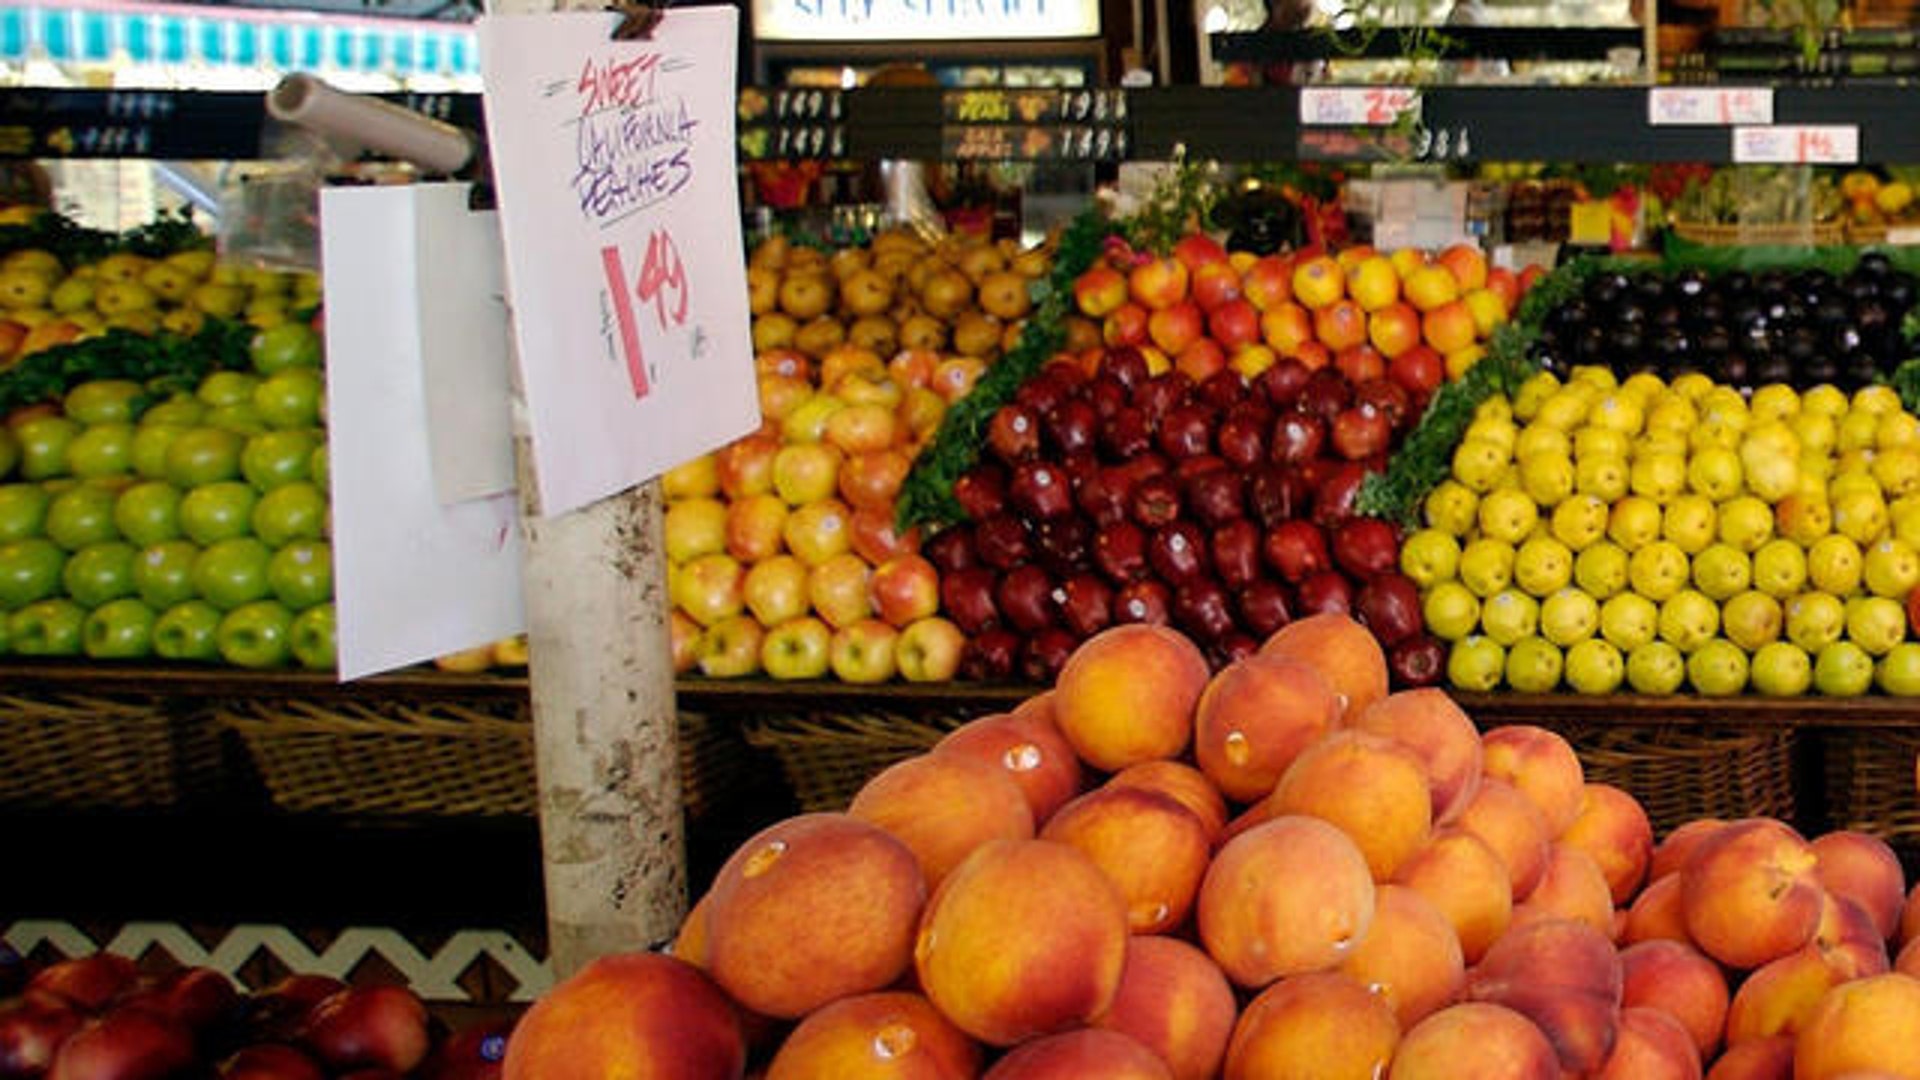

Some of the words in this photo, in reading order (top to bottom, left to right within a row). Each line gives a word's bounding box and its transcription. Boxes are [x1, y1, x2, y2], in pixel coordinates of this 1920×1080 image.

[578, 54, 661, 115] SWEET
[578, 97, 698, 171] CALIFORNIA
[572, 147, 692, 217] PEACHES
